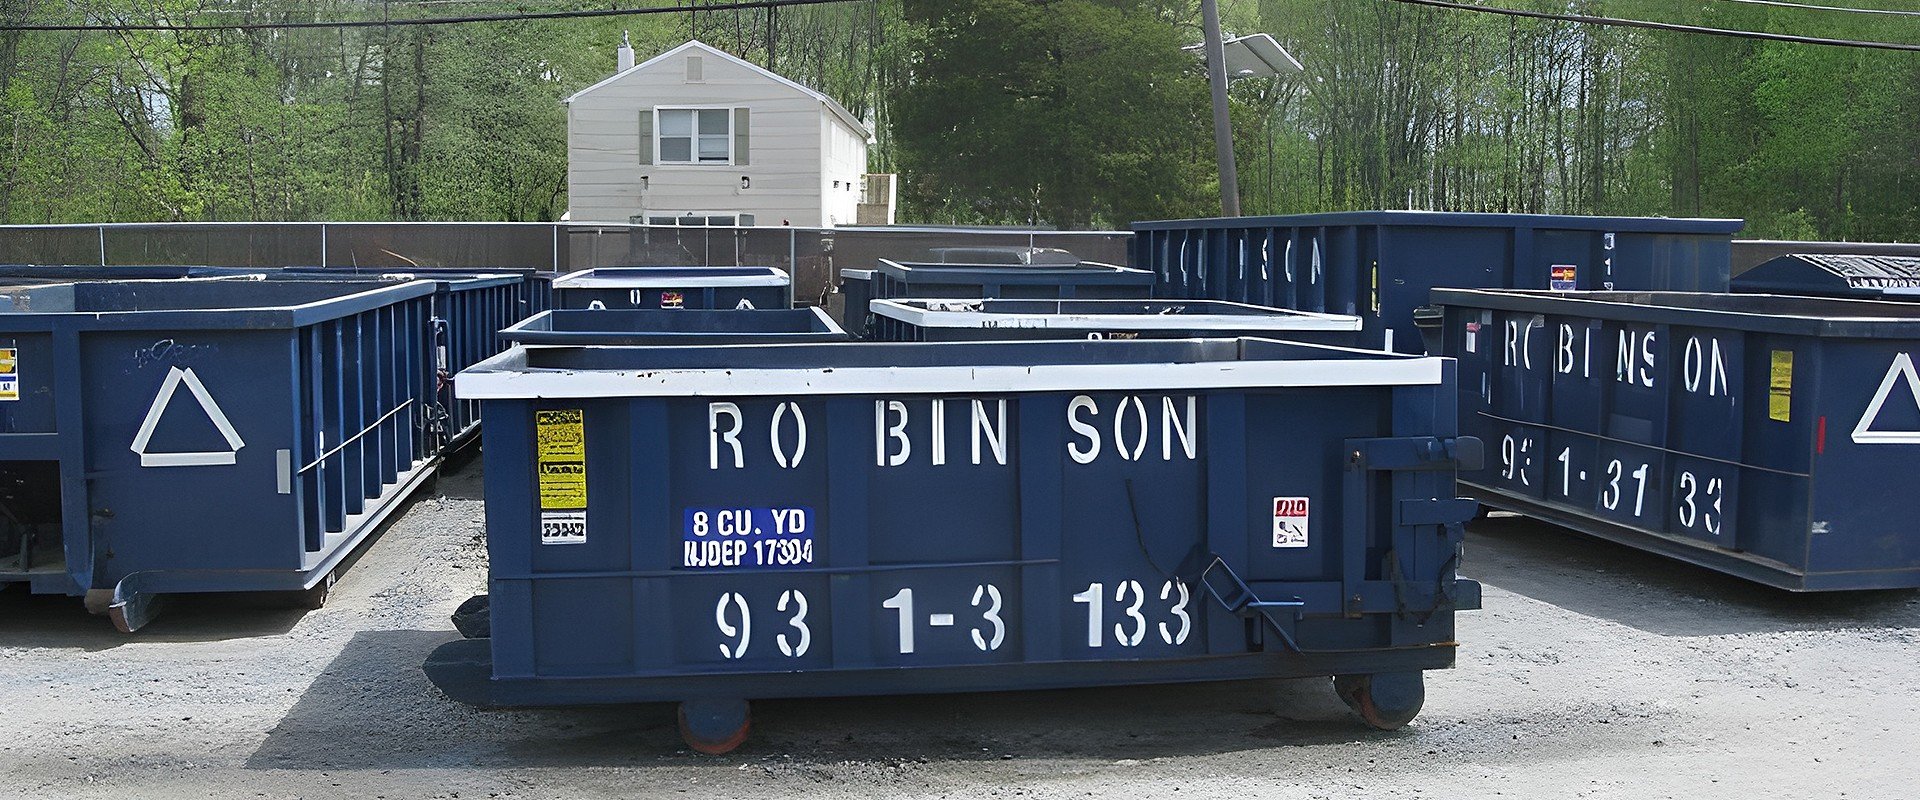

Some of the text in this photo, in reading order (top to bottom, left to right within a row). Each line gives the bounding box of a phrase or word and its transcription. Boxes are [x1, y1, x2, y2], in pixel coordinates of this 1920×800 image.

[693, 508, 806, 537] 8 CU. YD
